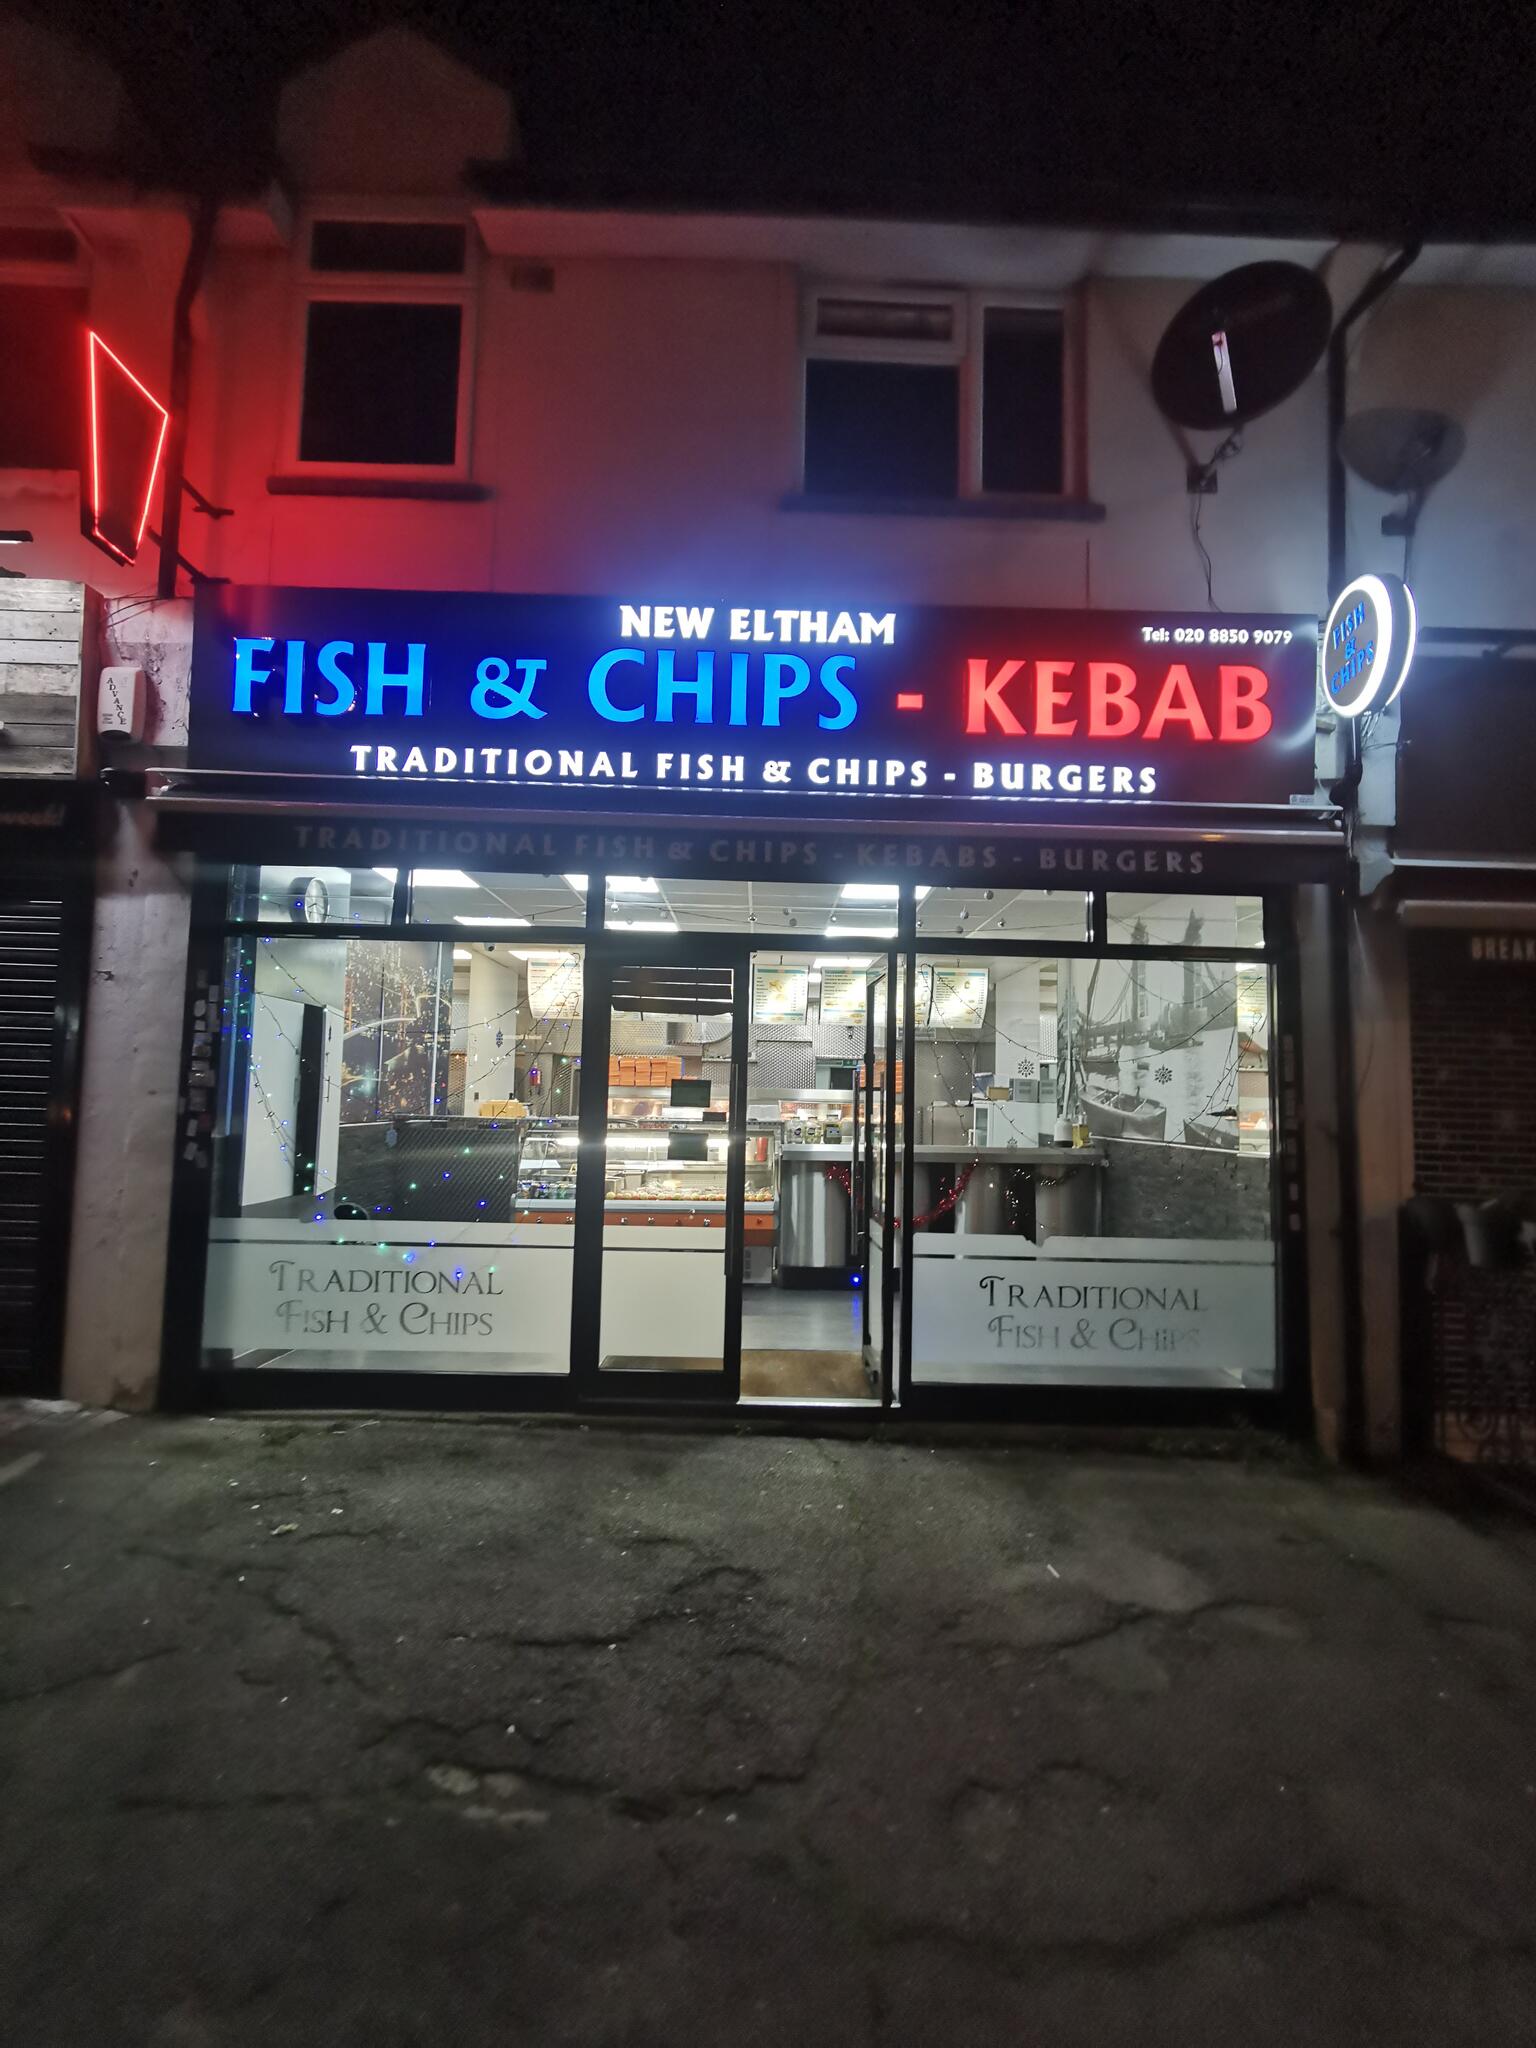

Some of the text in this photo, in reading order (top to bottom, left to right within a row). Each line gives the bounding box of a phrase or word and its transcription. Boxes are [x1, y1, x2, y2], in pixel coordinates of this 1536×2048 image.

[620, 604, 896, 645] NEW ELTHAM
[1142, 626, 1293, 645] Tel: 020 8850 9079
[1332, 601, 1365, 649] FISH
[232, 638, 427, 717] FISH
[470, 656, 548, 720] &
[587, 648, 858, 731] CHIPS
[965, 658, 1274, 743] KEBAB
[1331, 640, 1375, 695] CHIPS
[106, 677, 128, 725] ADVANCE
[350, 744, 638, 779] TRADITIONAL
[656, 752, 744, 782] FISH
[762, 760, 791, 784] &
[808, 758, 928, 787] CHIPS
[973, 762, 1158, 794] BURGERS
[294, 825, 557, 857] TRADITIONAL
[574, 834, 655, 861] FISH
[668, 841, 692, 861] &
[709, 839, 818, 866] CHIPS
[857, 842, 997, 869] KEBABS
[1039, 847, 1205, 875] BURGERS
[360, 1302, 388, 1335] &
[1069, 1317, 1098, 1350] &
